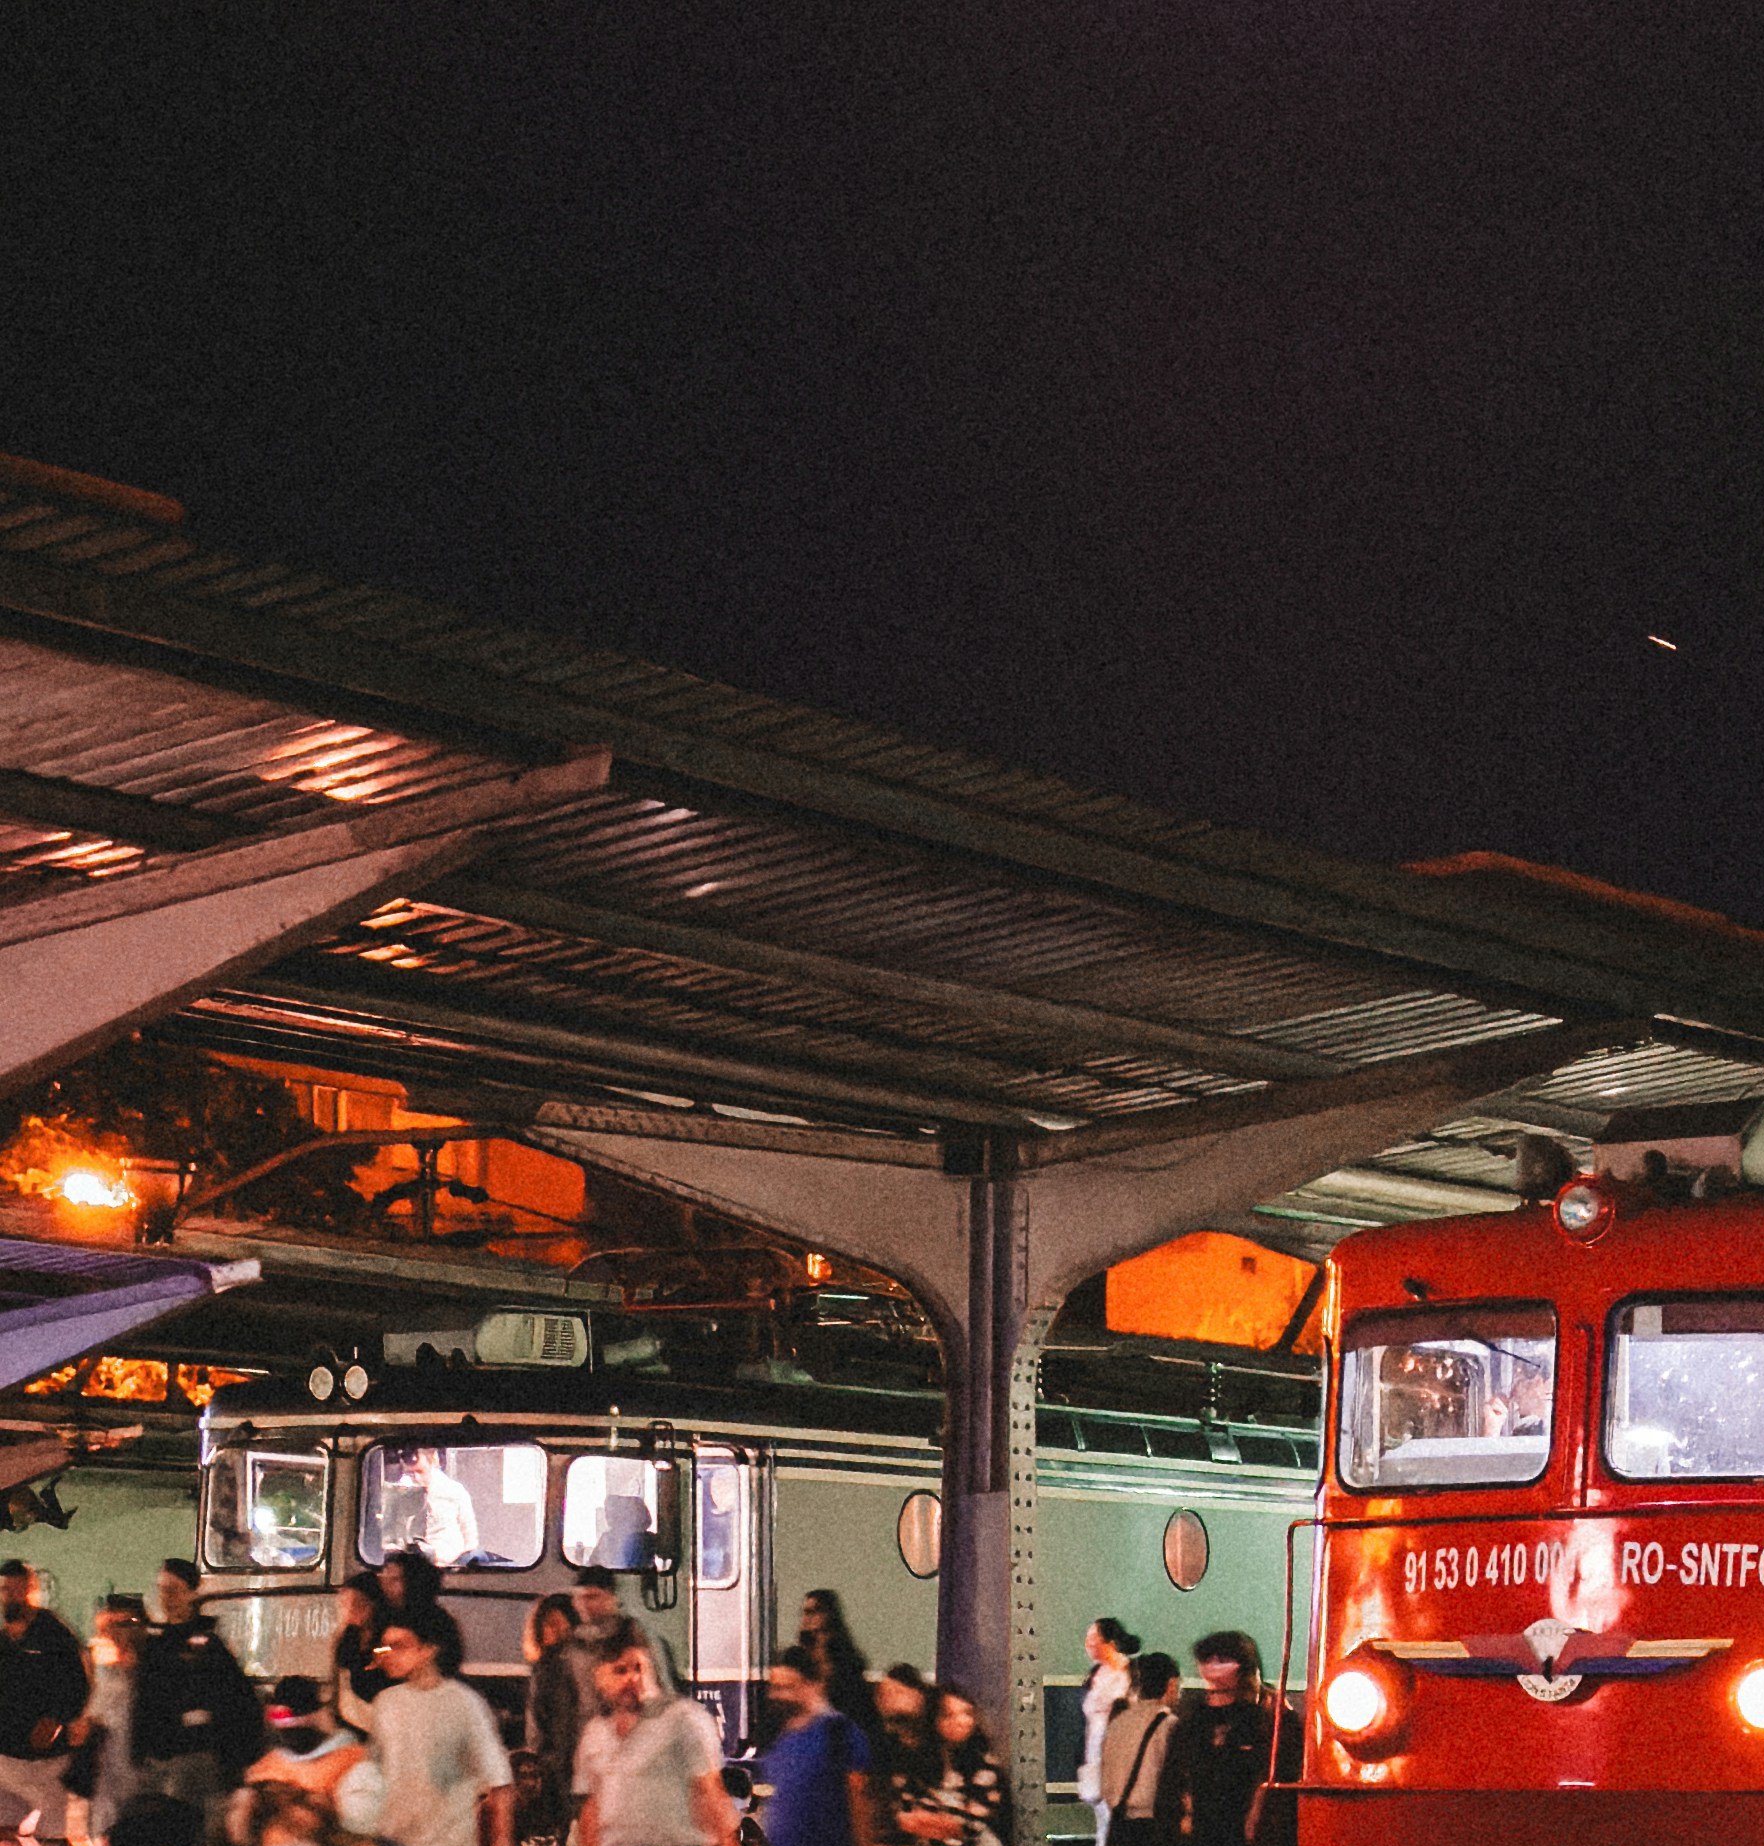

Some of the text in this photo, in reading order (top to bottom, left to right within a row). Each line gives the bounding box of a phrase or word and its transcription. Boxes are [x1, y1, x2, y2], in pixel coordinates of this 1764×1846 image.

[1404, 1550, 1427, 1593] 91
[1433, 1547, 1460, 1590] 53
[1464, 1546, 1479, 1587] 0
[1485, 1543, 1527, 1586] 410
